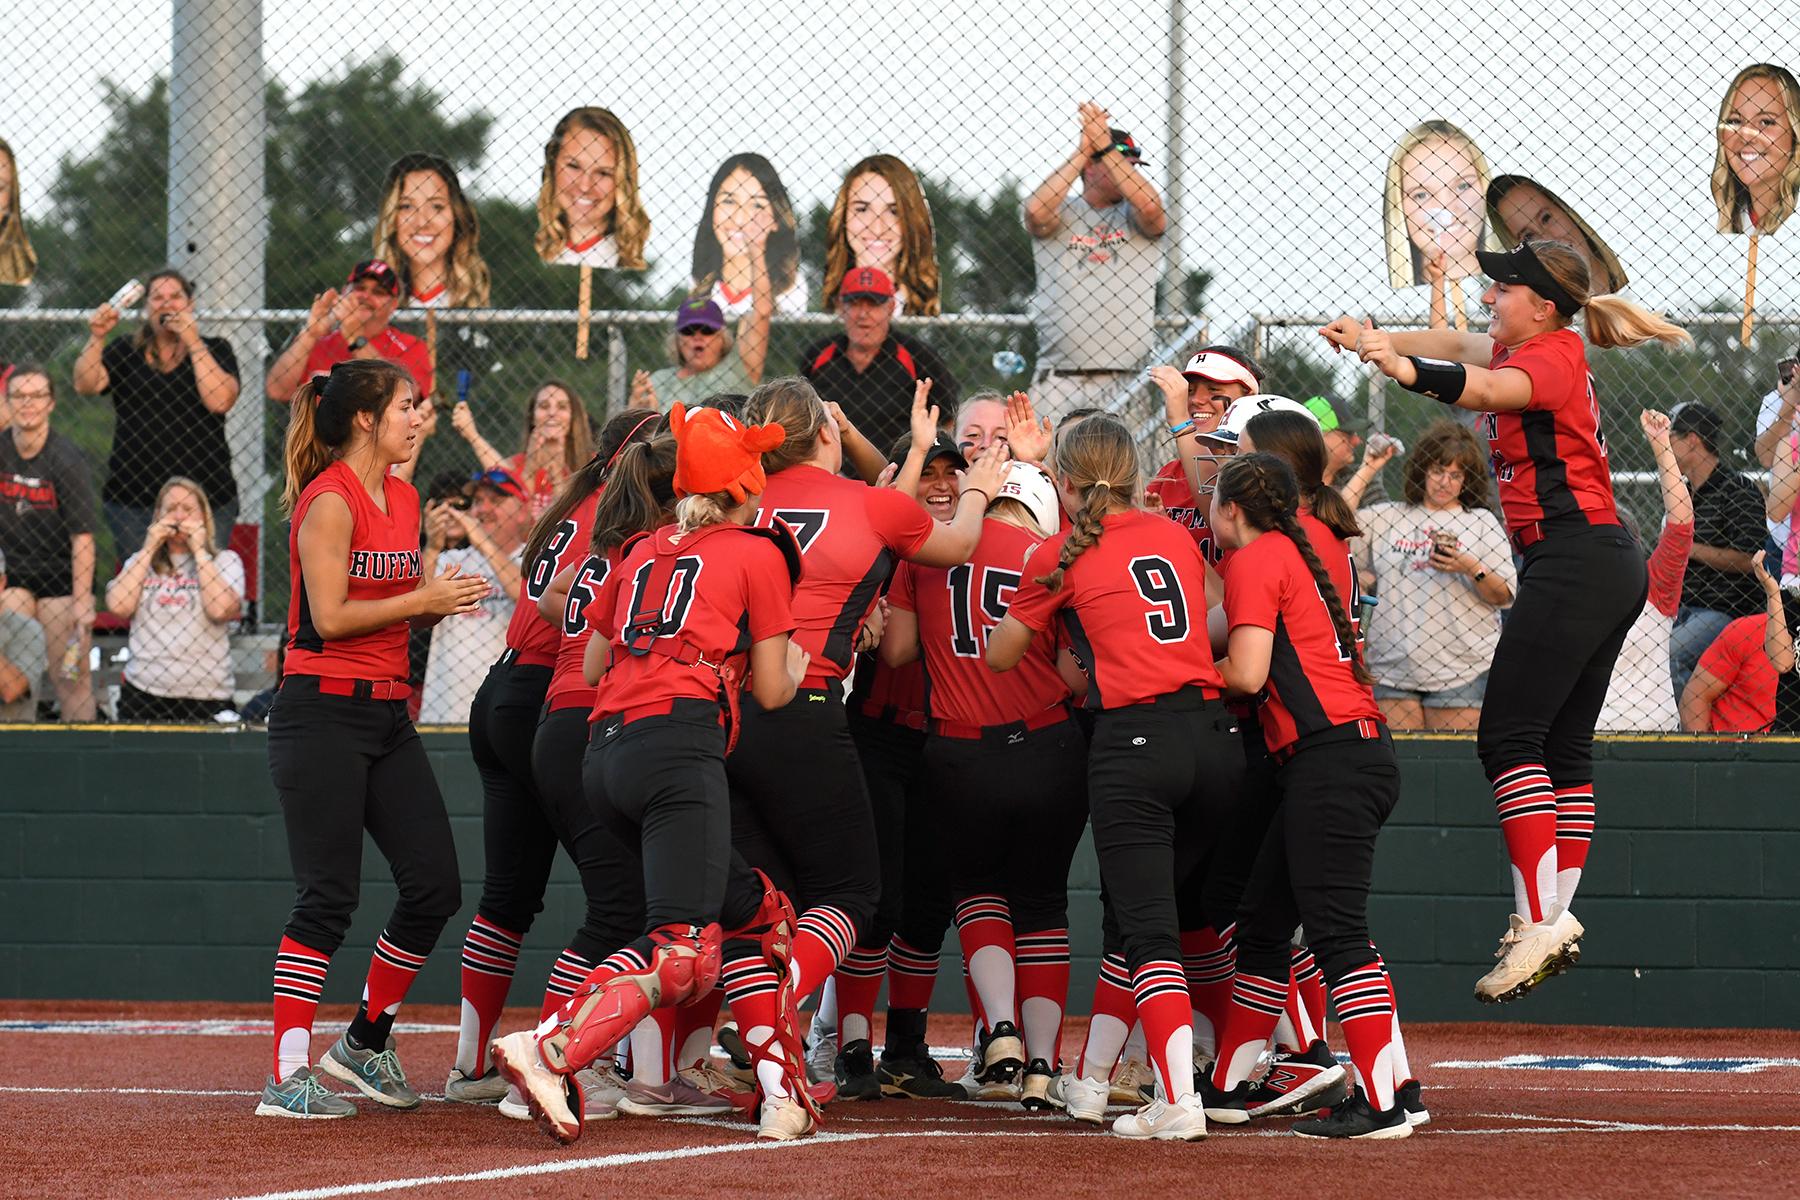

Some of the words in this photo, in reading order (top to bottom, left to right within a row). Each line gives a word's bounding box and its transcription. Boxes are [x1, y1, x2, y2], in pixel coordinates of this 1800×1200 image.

[1196, 354, 1207, 364] H
[1001, 484, 1022, 495] 15
[527, 519, 578, 602] 8
[753, 507, 831, 556] 7
[563, 554, 612, 638] 6
[621, 554, 704, 645] 10
[946, 562, 1023, 659] 15
[1128, 554, 1190, 645] 9
